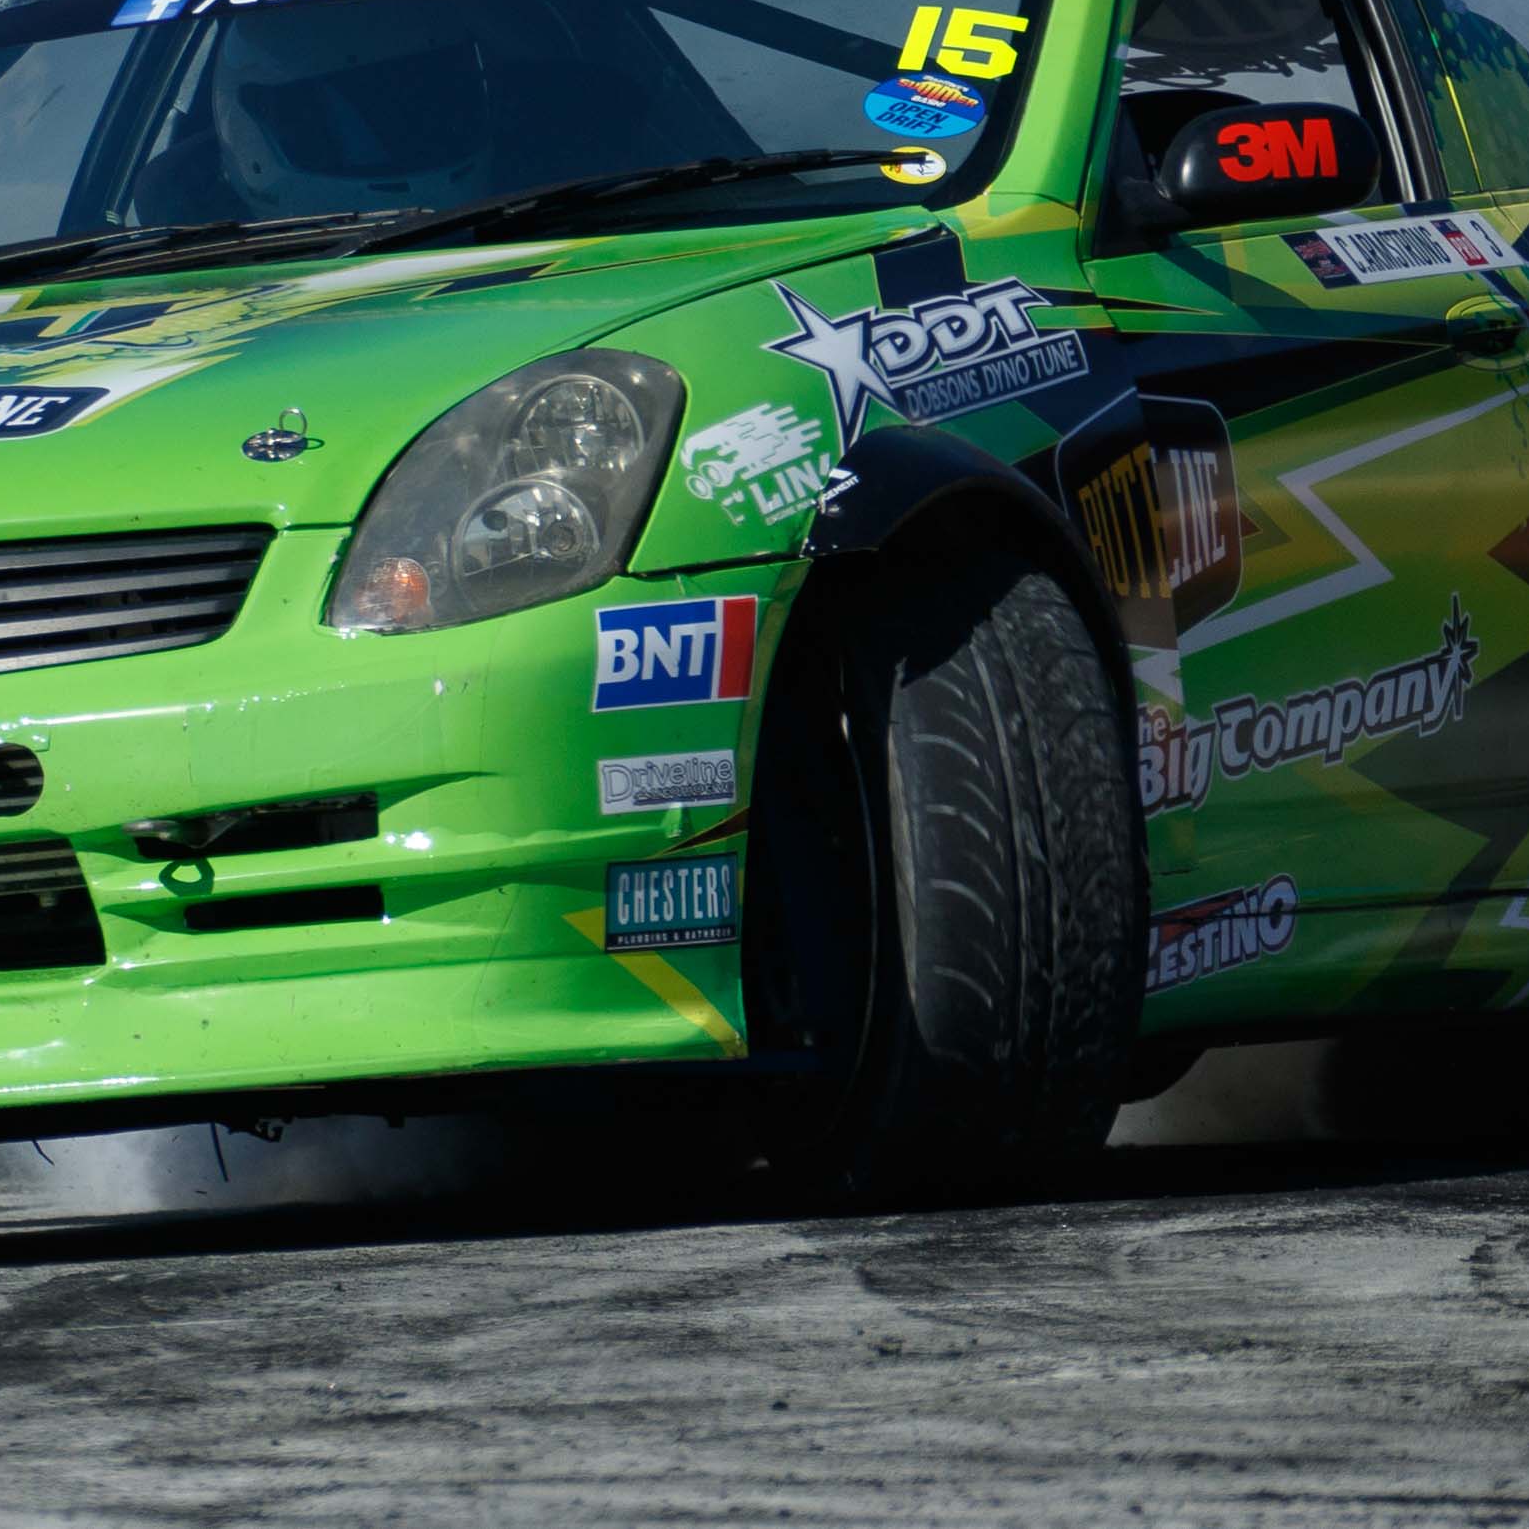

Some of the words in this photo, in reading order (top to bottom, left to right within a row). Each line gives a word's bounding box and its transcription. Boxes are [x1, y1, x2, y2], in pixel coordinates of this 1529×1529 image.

[897, 5, 1029, 79] 15
[875, 111, 943, 135] DRIFT
[888, 102, 949, 125] OPEN
[1217, 118, 1339, 182] 3M
[1470, 220, 1504, 257] 3
[870, 284, 1035, 373] DDT
[905, 369, 982, 418] DOBSONS
[981, 354, 1030, 396] DYNO
[1027, 339, 1079, 379] TUNE
[598, 621, 716, 684] BNT
[1138, 711, 1168, 746] he
[603, 757, 734, 804] Driveline
[617, 865, 730, 925] CHESTERS
